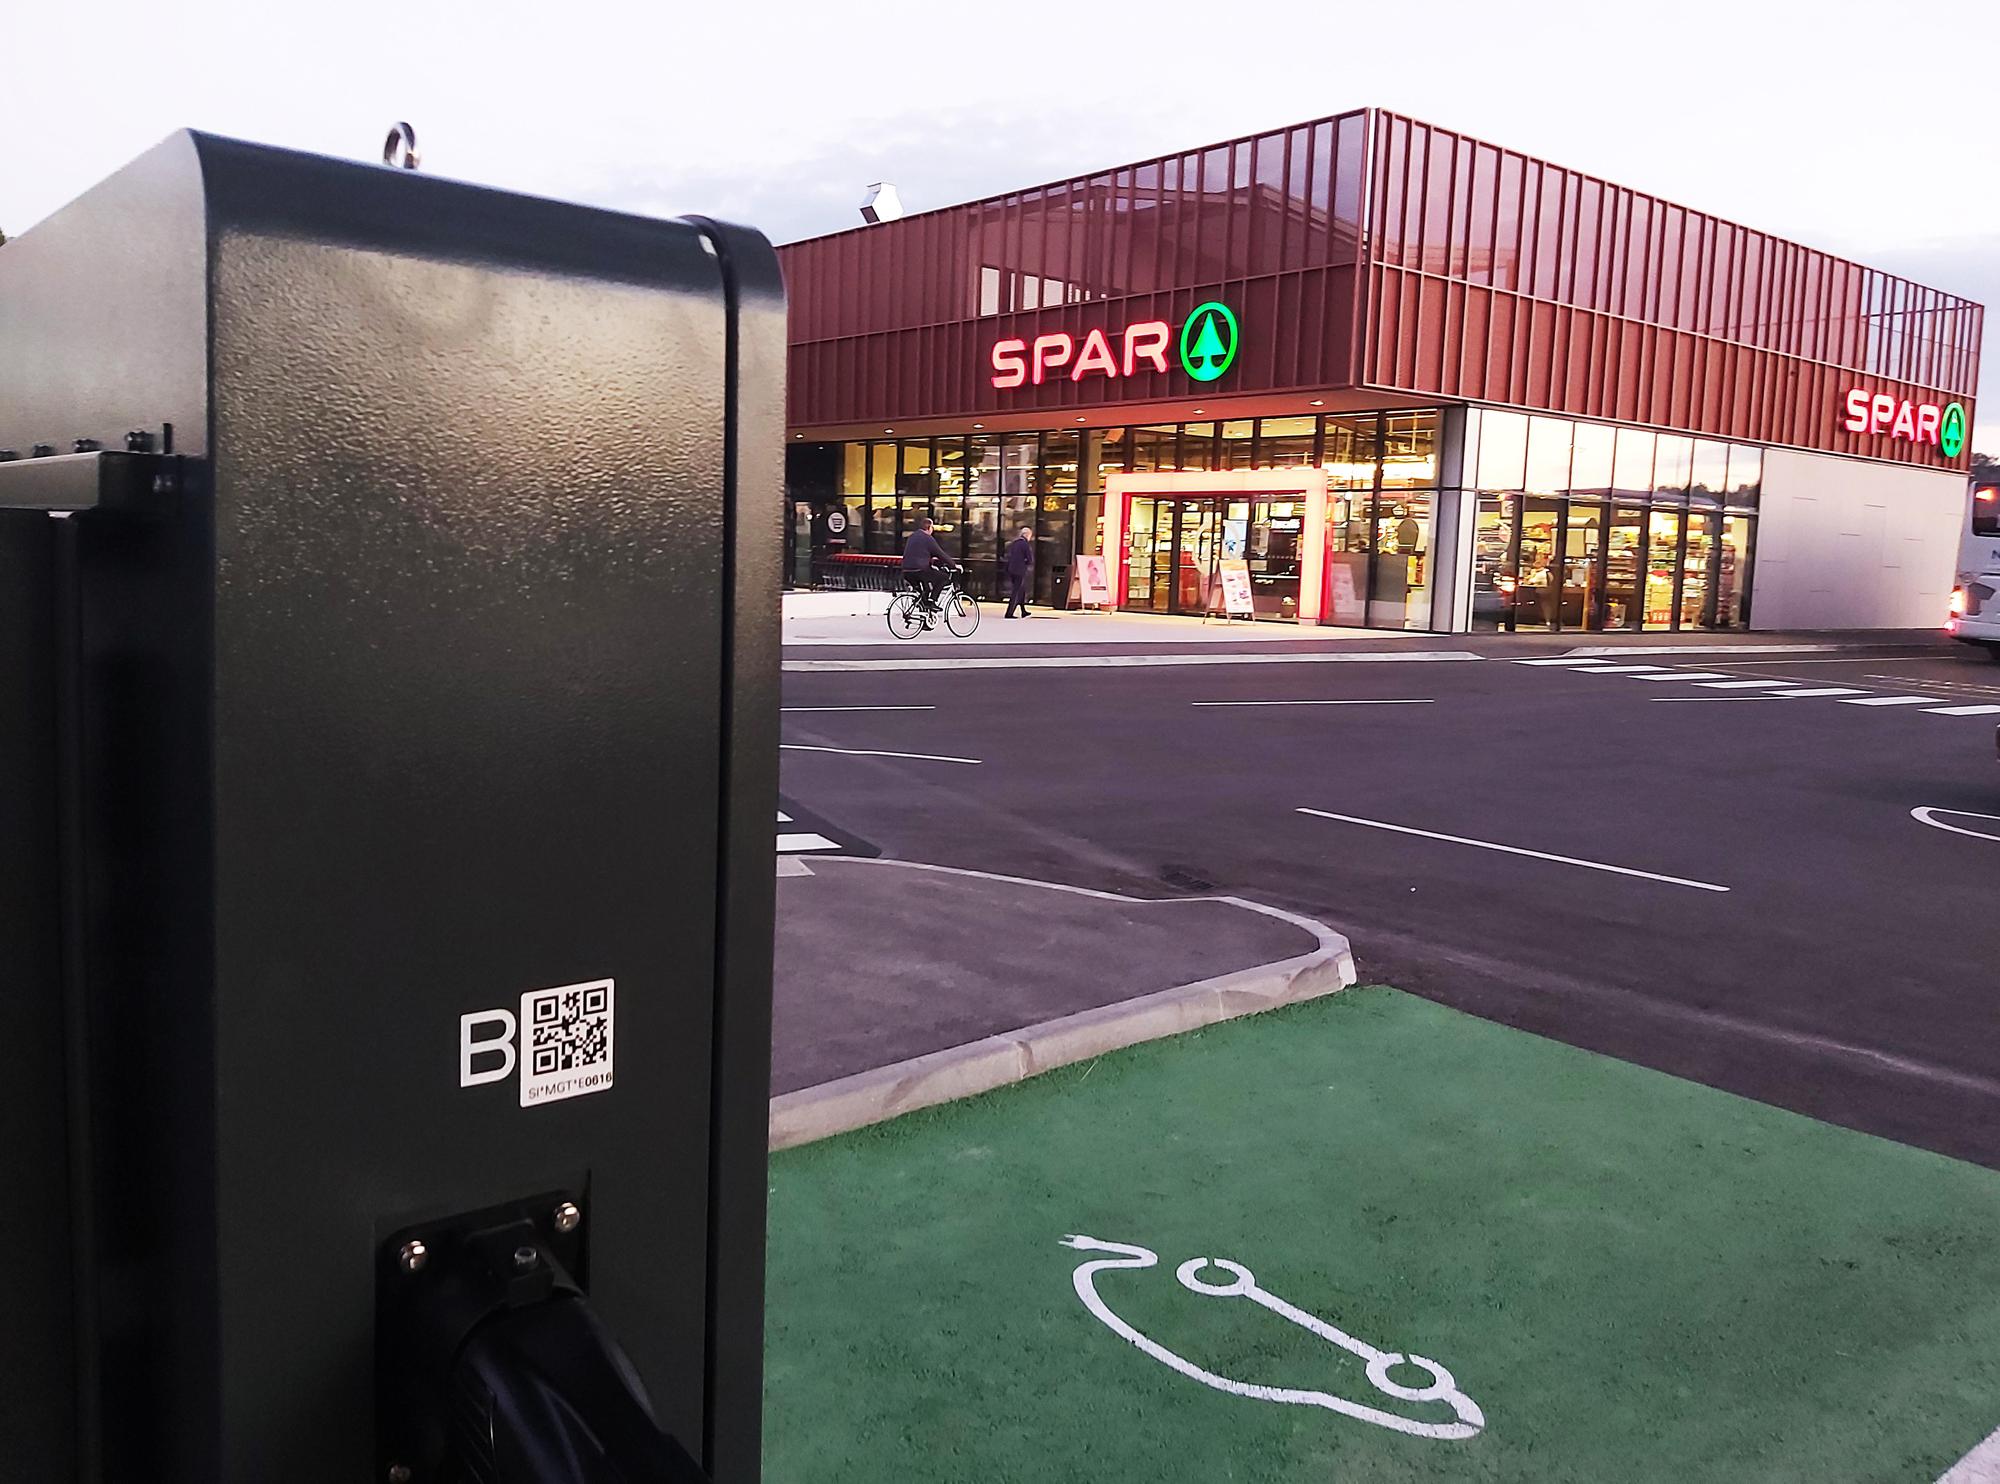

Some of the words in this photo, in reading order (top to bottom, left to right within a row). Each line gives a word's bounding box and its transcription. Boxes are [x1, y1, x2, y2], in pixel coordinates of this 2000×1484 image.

[991, 320, 1170, 389] SPAR
[1845, 388, 1941, 445] SPAR
[460, 1008, 517, 1088] B
